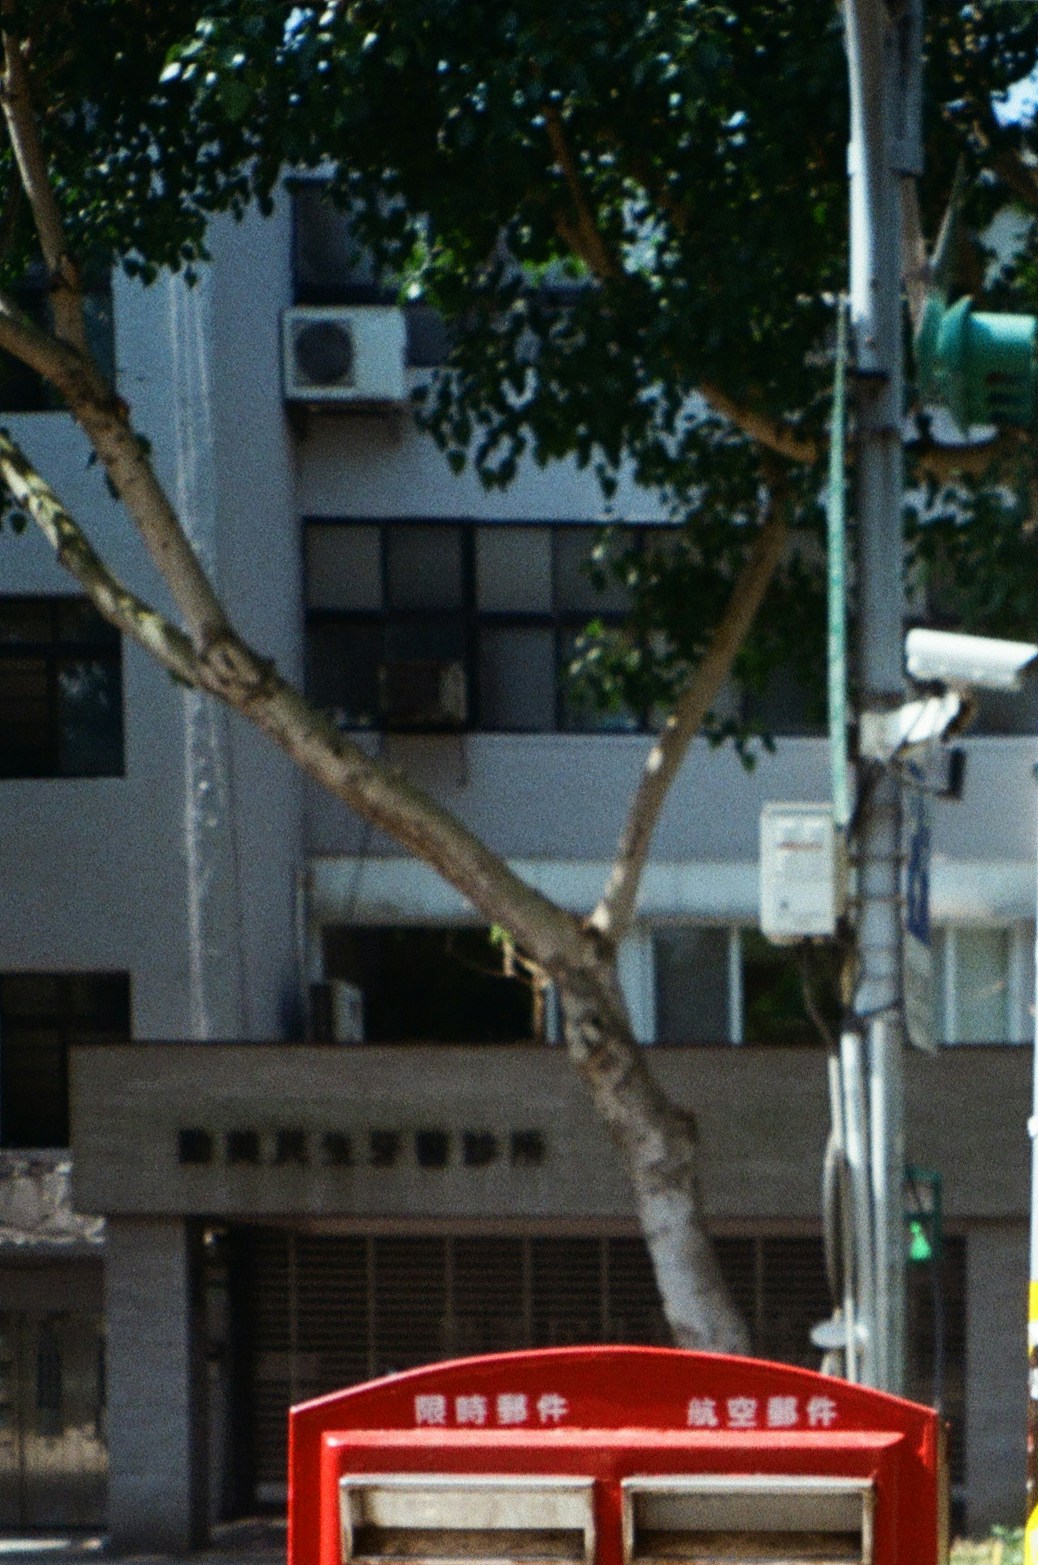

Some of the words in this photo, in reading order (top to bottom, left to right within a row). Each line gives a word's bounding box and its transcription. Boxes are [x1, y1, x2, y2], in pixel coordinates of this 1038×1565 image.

[414, 1393, 568, 1425] 限時郵件
[687, 1396, 838, 1427] 航空郵件
